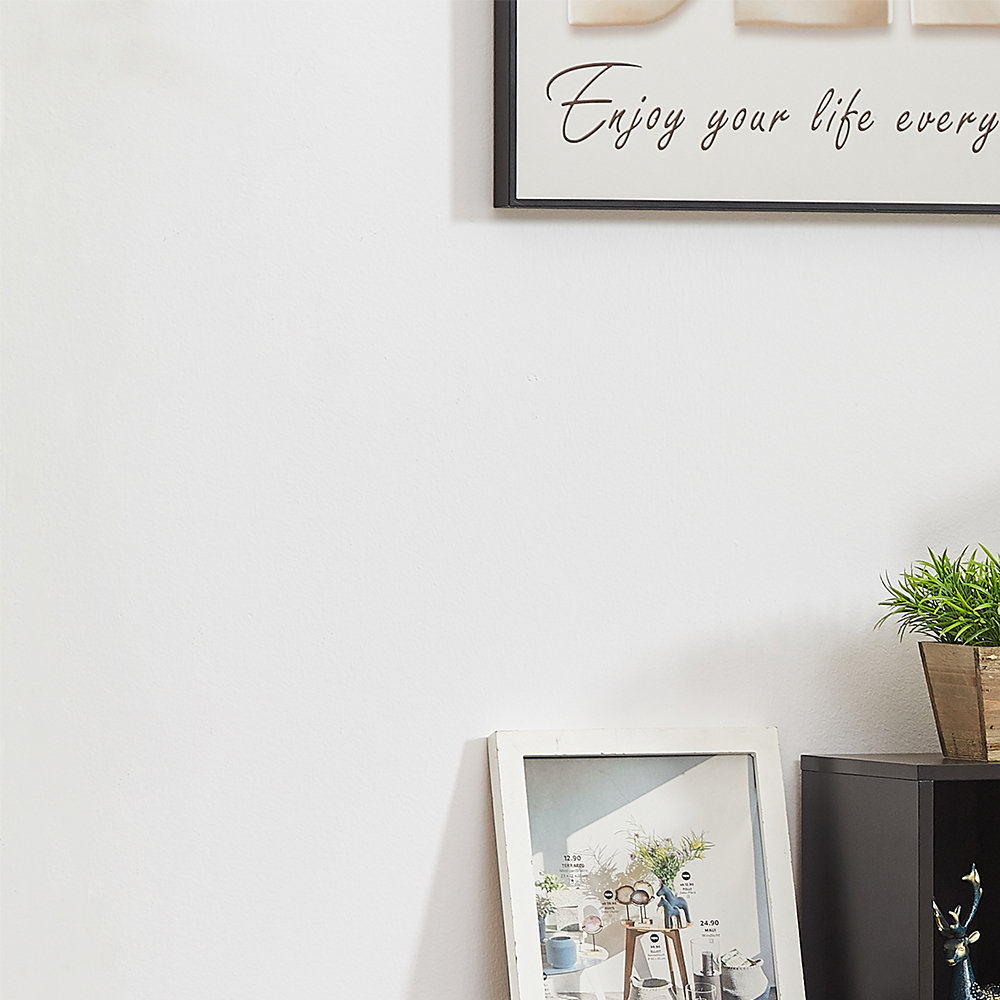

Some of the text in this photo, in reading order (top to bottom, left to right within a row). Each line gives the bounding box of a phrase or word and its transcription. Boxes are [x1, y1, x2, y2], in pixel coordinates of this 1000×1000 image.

[546, 62, 686, 150] Enjoy
[700, 109, 790, 151] your
[810, 88, 875, 151] life
[896, 108, 999, 154] every
[699, 919, 720, 927] 24.90
